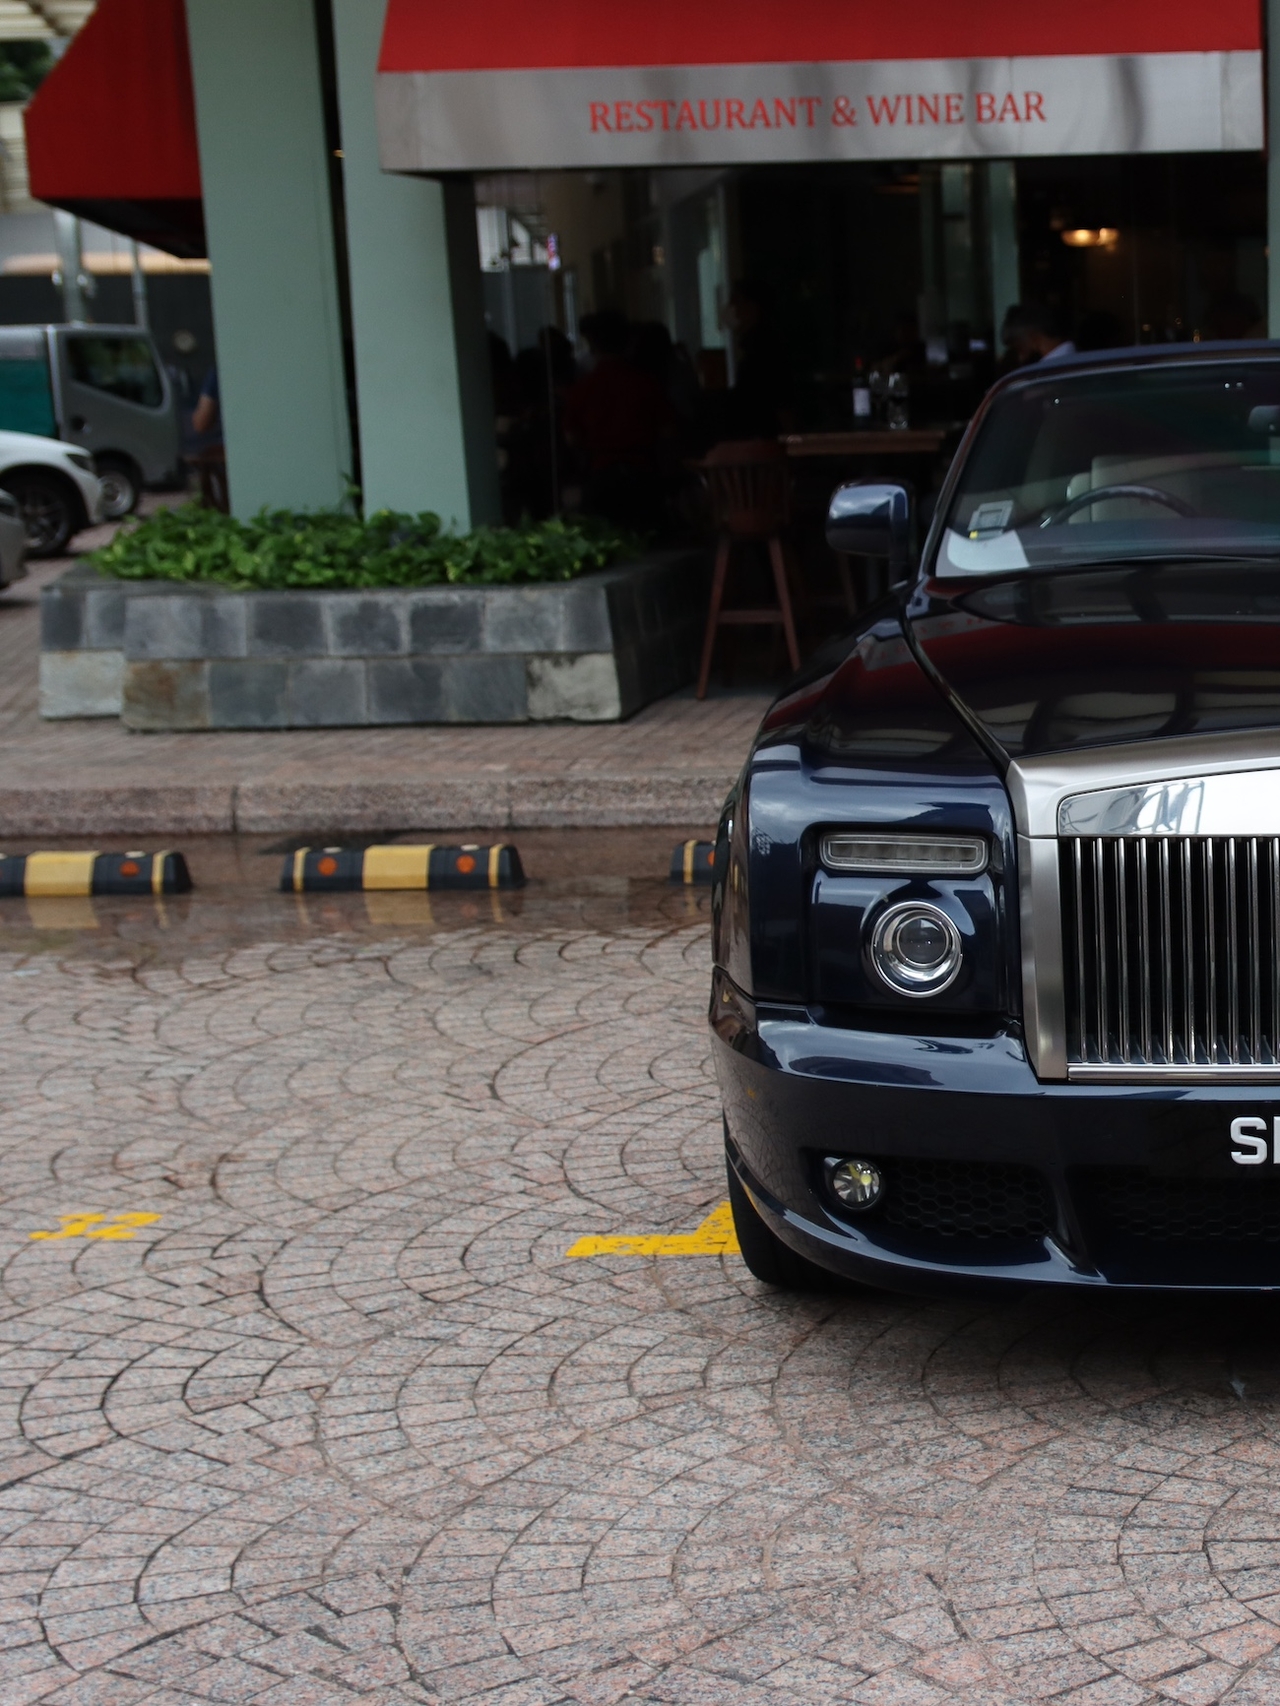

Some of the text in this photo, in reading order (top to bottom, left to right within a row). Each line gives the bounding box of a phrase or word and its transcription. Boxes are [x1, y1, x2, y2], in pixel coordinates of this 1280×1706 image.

[588, 90, 1048, 133] RESTAURANT & WINE BAR
